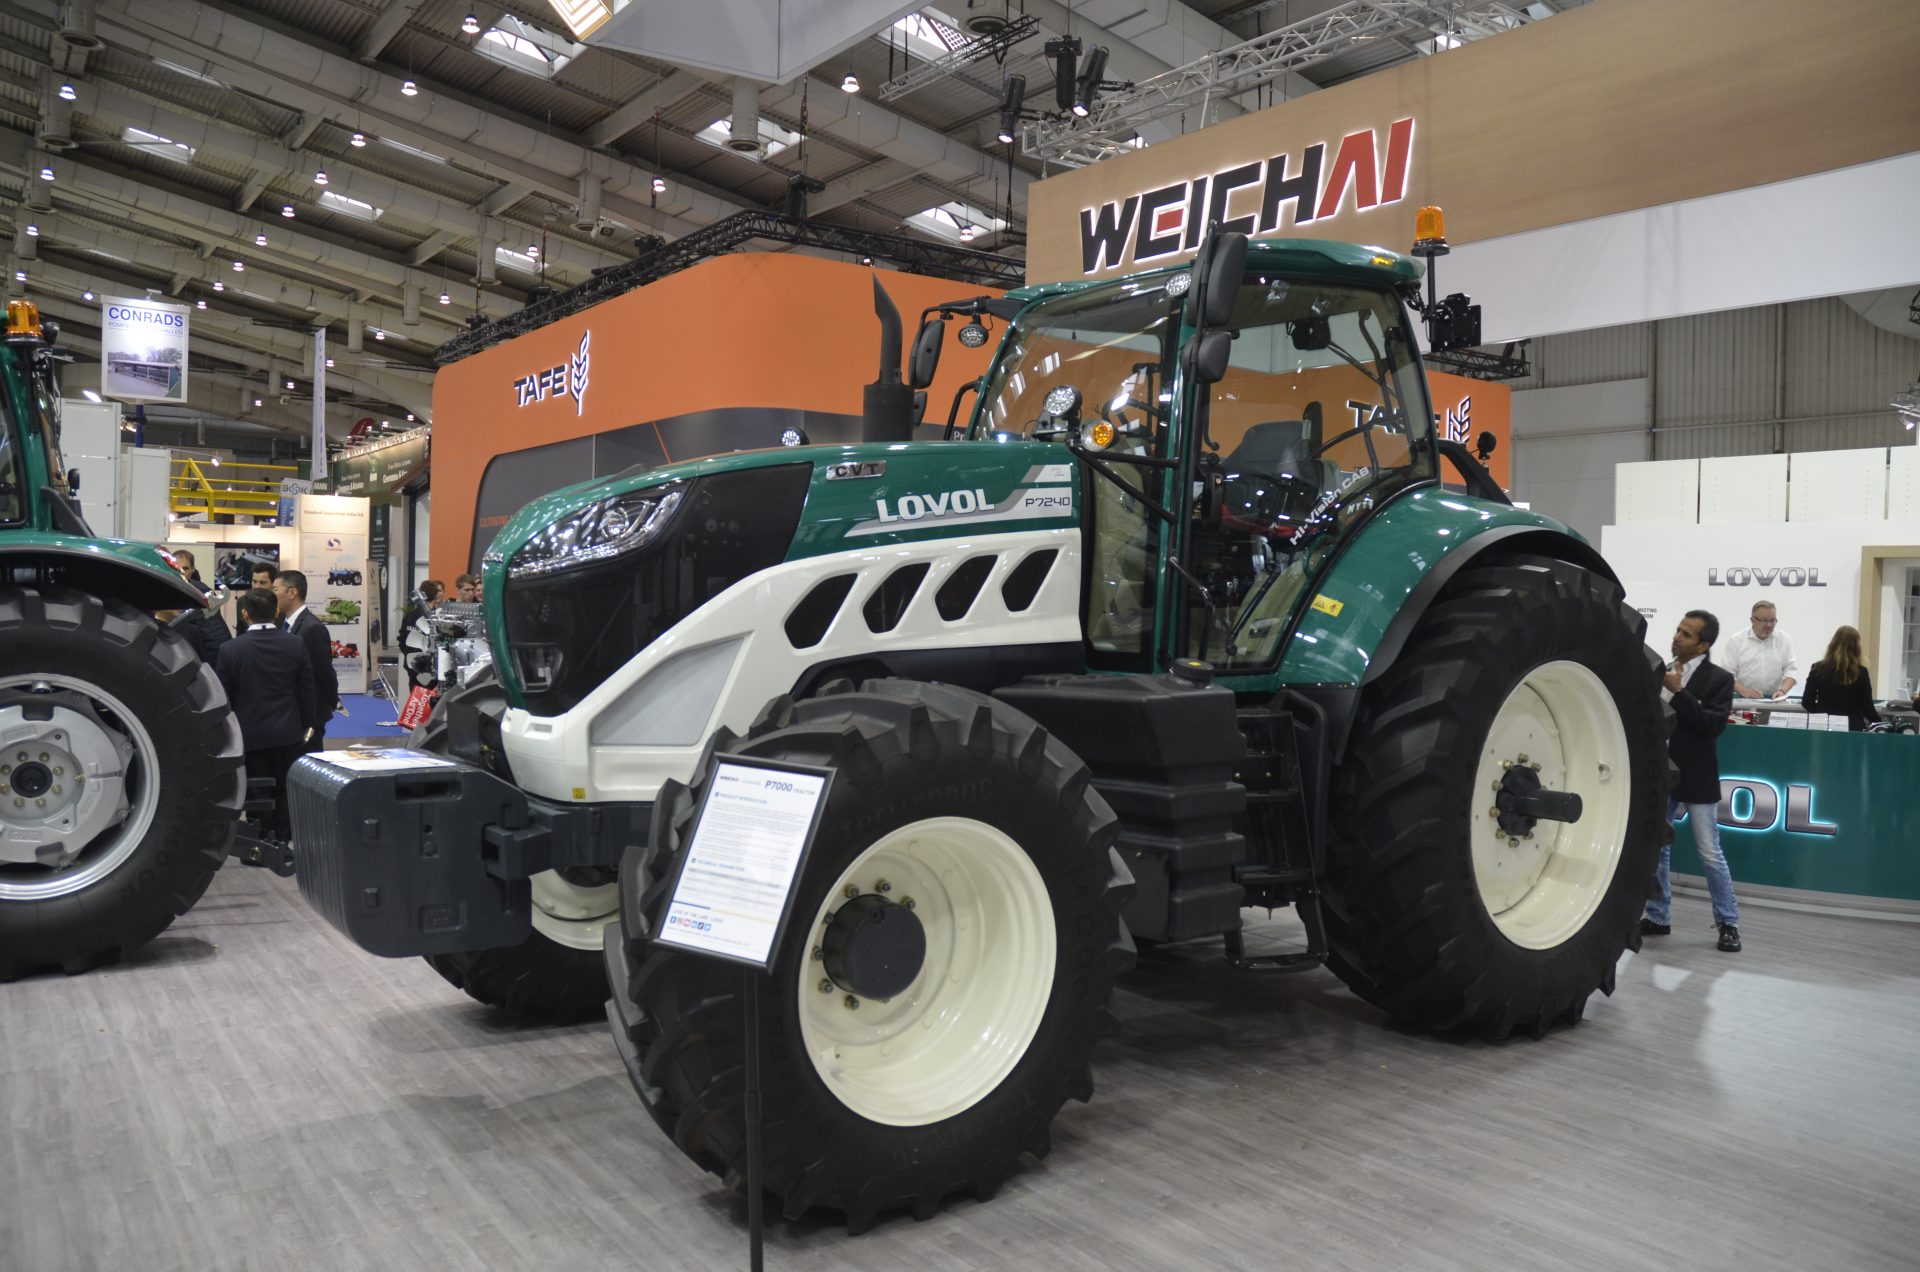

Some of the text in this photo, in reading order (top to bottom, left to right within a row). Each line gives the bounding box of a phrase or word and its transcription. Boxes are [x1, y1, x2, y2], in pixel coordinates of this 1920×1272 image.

[1080, 117, 1415, 275] WEICHAI
[108, 306, 184, 327] CONRADS
[513, 363, 568, 407] TAFE
[834, 463, 879, 478] CVT
[1342, 466, 1370, 490] CAB
[876, 488, 995, 523] LOVOL
[1025, 496, 1071, 508] P7240
[1708, 567, 1827, 587] LOVOL
[764, 780, 793, 792] P7000
